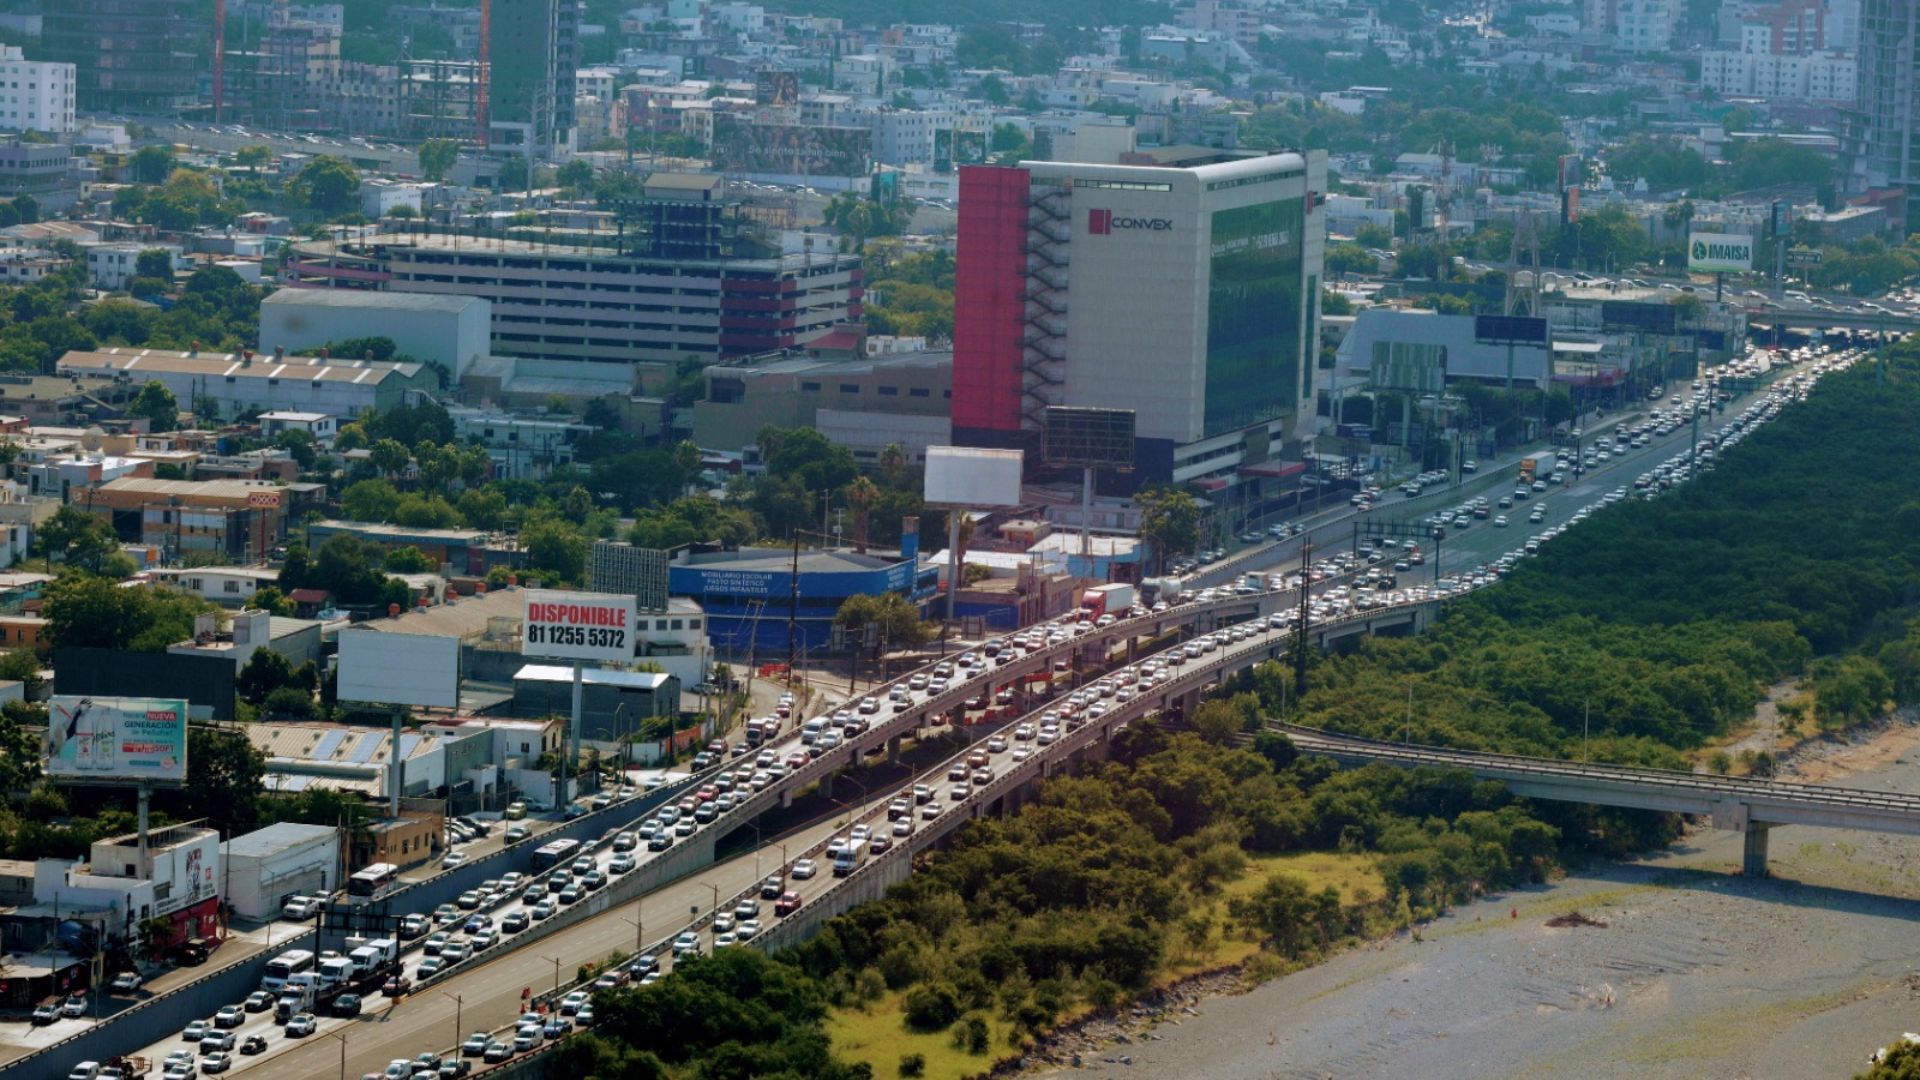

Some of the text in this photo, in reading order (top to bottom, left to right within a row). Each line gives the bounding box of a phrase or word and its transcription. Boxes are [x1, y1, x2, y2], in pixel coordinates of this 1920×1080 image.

[1111, 217, 1173, 231] CONVEX
[1708, 244, 1750, 260] IMAISA
[250, 495, 280, 505] OXXO
[729, 586, 769, 594] INFANTILES
[528, 602, 626, 628] DISPONIBLE
[528, 624, 625, 649] 81 1255 5372
[147, 712, 176, 721] NUEVA
[124, 720, 177, 729] GENERACIÓN
